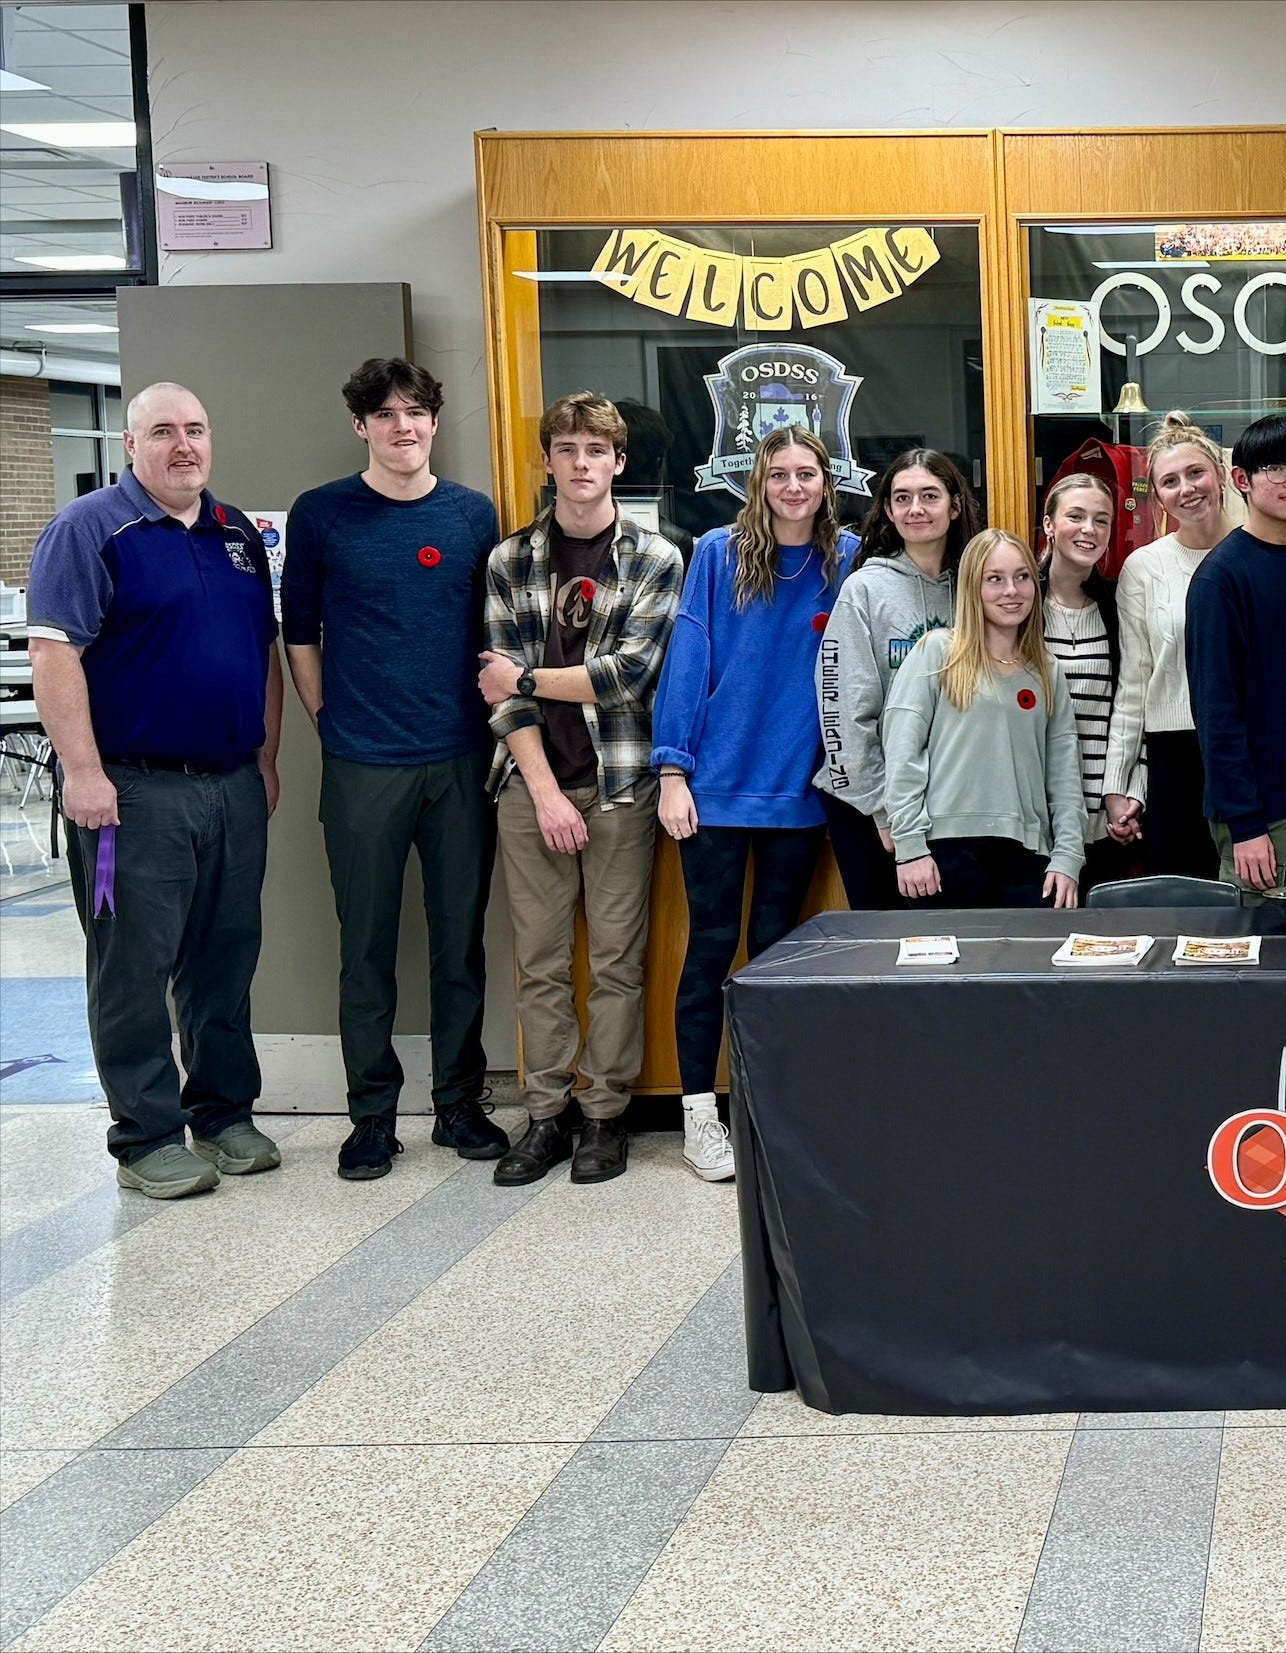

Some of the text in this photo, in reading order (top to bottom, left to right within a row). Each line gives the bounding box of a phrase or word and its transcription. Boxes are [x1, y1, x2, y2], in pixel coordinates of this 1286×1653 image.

[606, 228, 924, 321] WELCOME
[741, 361, 819, 385] OSDSS
[743, 391, 818, 401] 20 16
[720, 459, 754, 469] Togeth
[821, 639, 850, 790] CHEERLEADING
